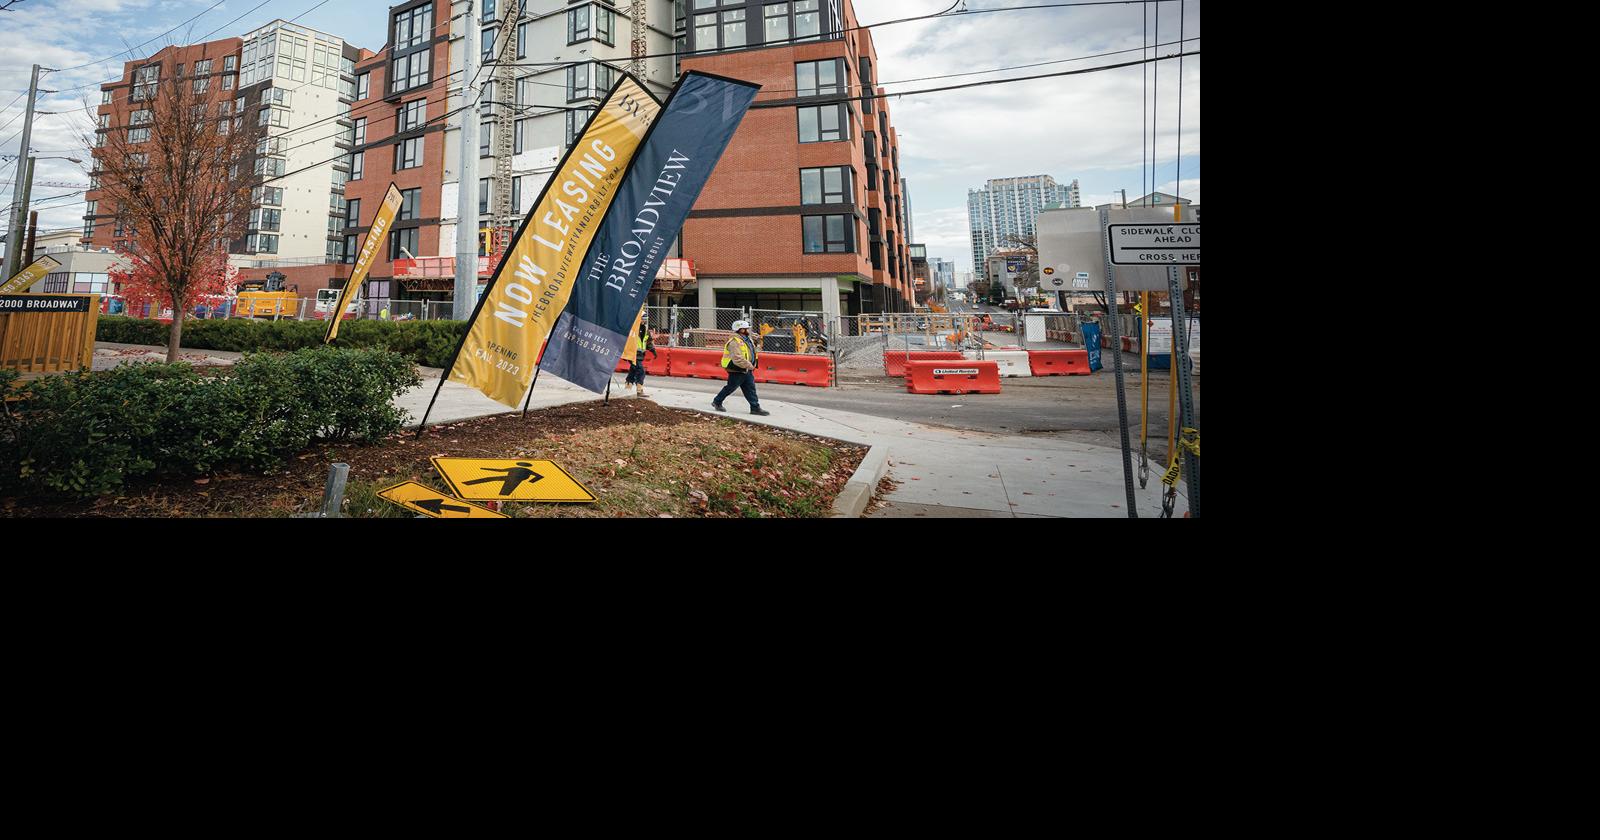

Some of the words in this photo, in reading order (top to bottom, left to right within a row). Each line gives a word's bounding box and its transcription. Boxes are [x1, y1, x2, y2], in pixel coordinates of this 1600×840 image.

[605, 148, 691, 292] BROADVIEW
[1121, 227, 1174, 235] SIDEWALK
[354, 216, 386, 274] LEASING
[494, 254, 547, 328] NOW
[532, 139, 616, 252] LEASING
[588, 252, 611, 281] THE
[629, 287, 639, 298] AT
[635, 236, 665, 286] VANDERBILT
[1139, 253, 1175, 261] CROSS
[0, 300, 23, 308] 2000
[26, 300, 79, 309] BROADWAY
[584, 331, 593, 339] OR
[594, 334, 608, 344] TEXT
[496, 358, 520, 376] 2023
